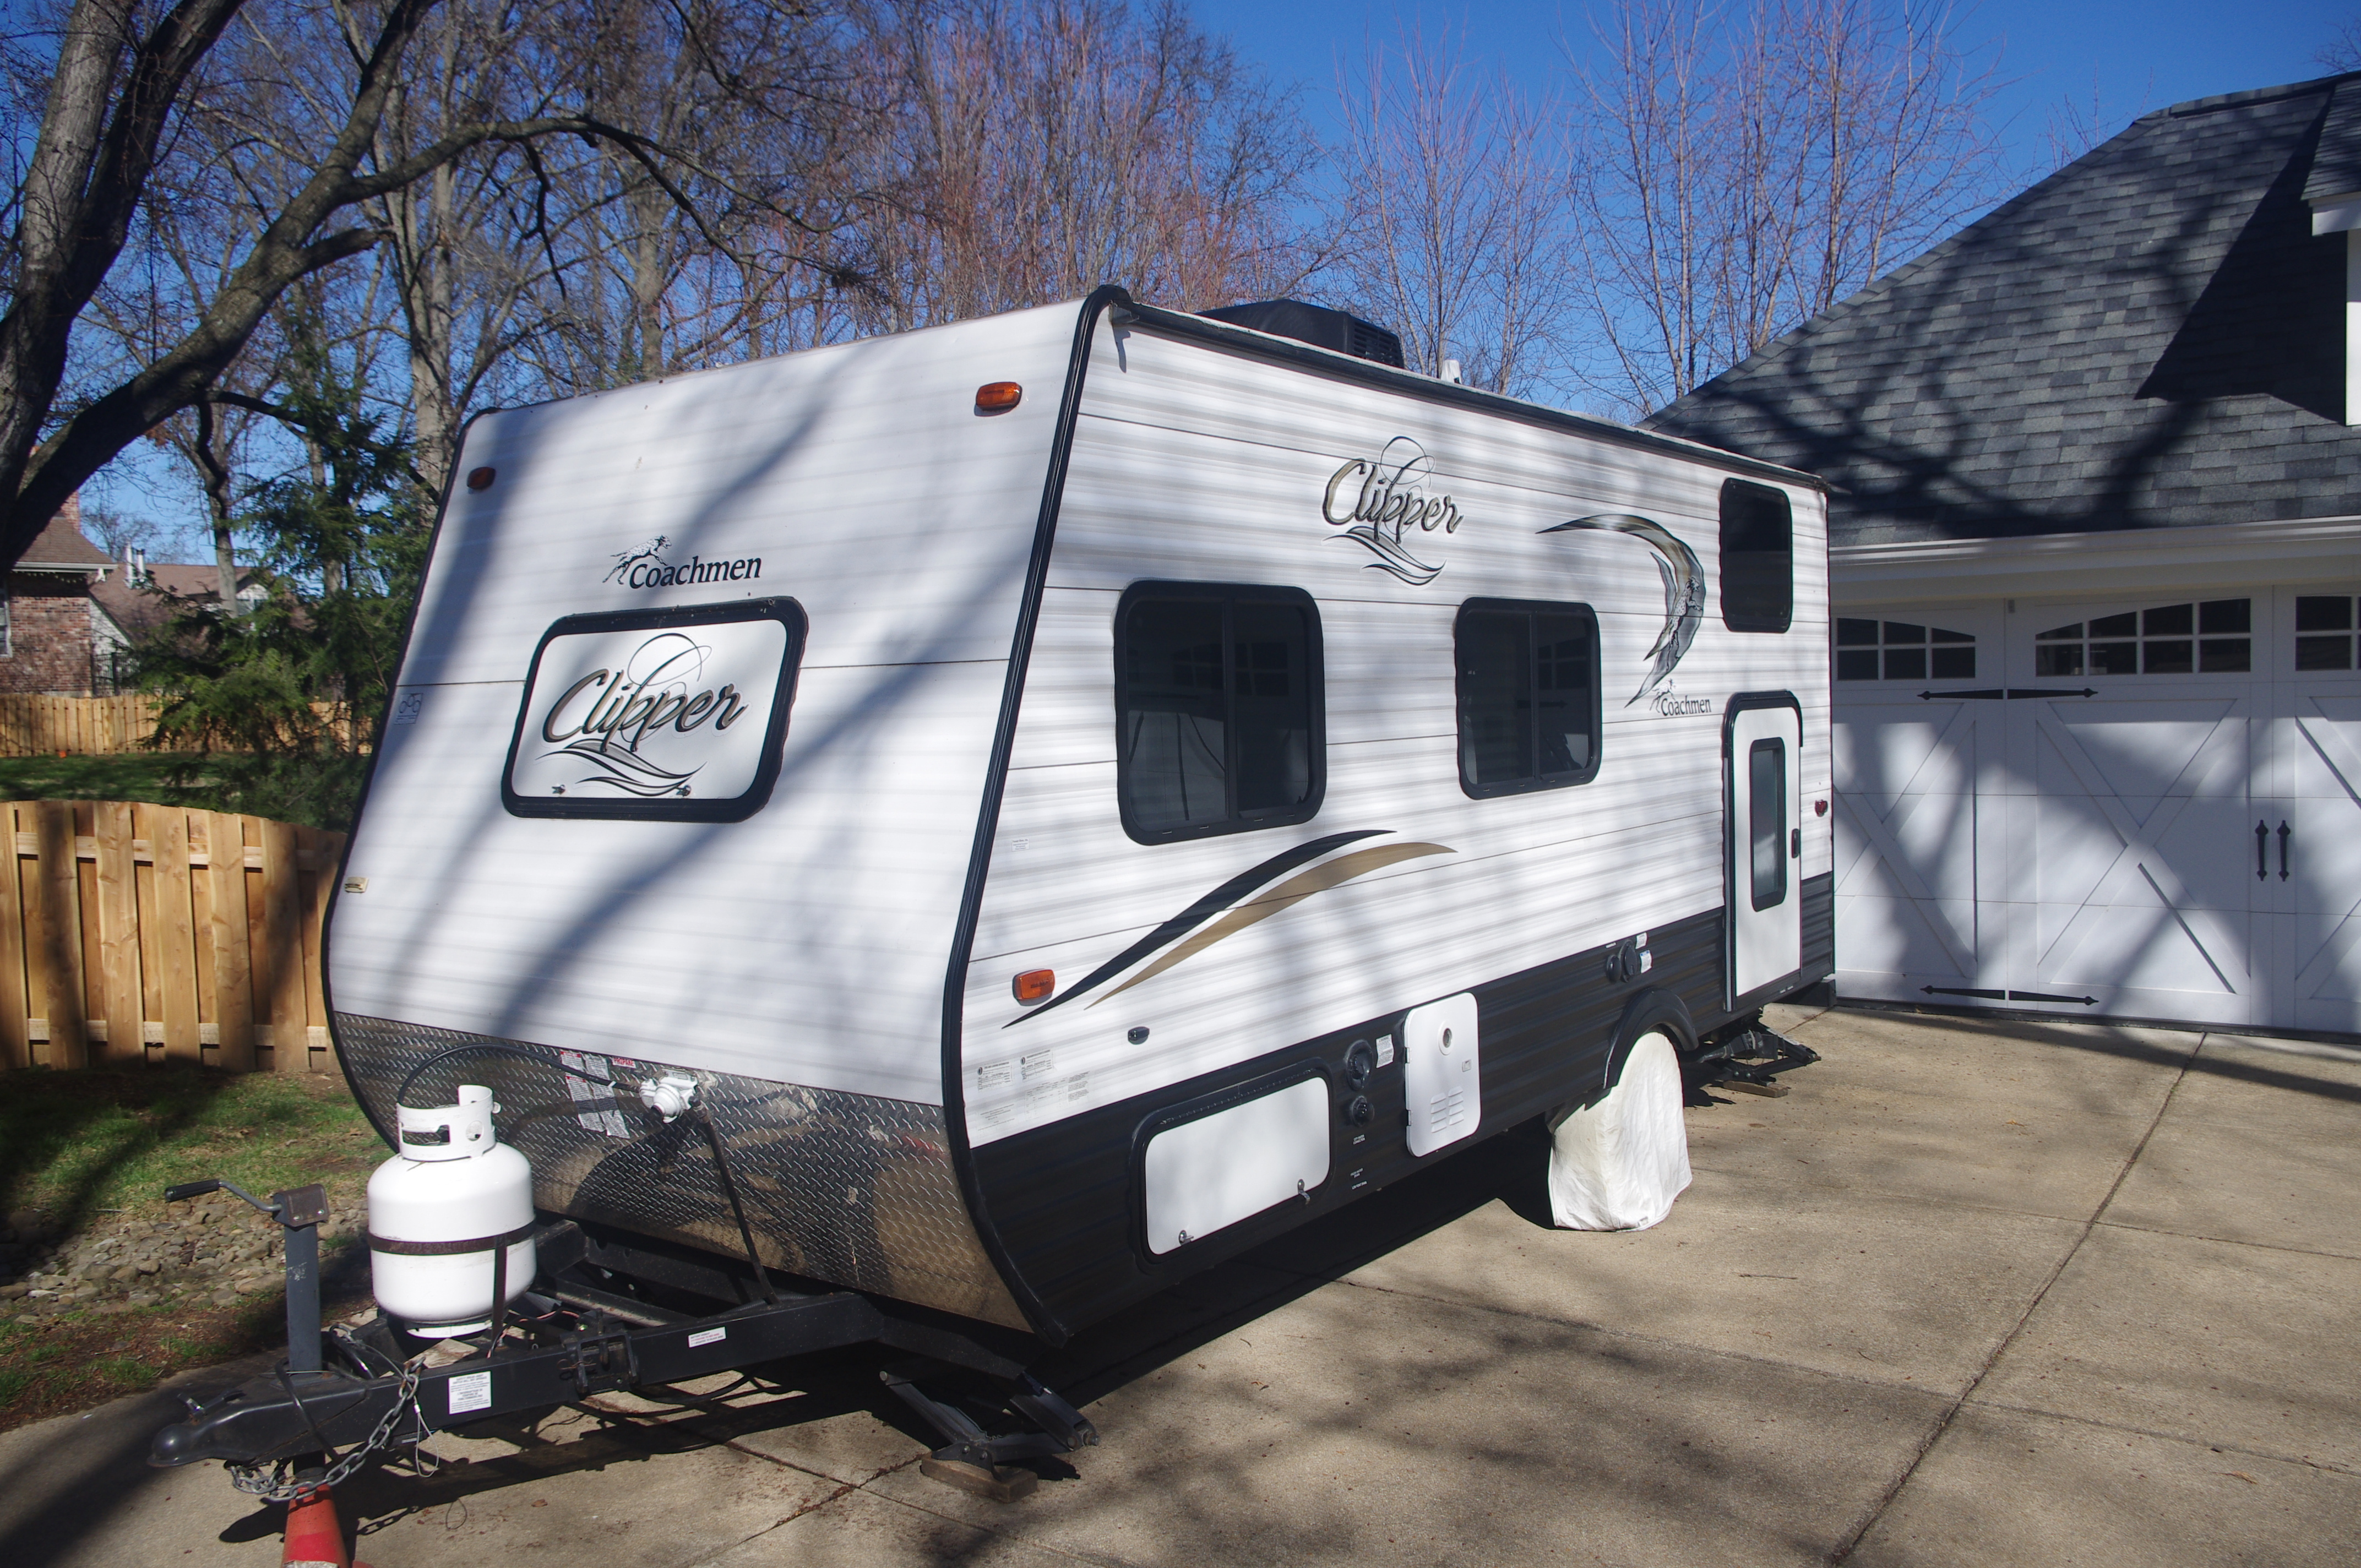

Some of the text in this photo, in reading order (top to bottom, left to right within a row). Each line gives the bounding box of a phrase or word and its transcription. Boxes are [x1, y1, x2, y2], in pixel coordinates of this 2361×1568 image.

[1323, 435, 1465, 544] Clipper
[628, 555, 763, 589] Coachmen
[542, 632, 749, 753] Clipper
[1661, 696, 1712, 717] Coachmen
